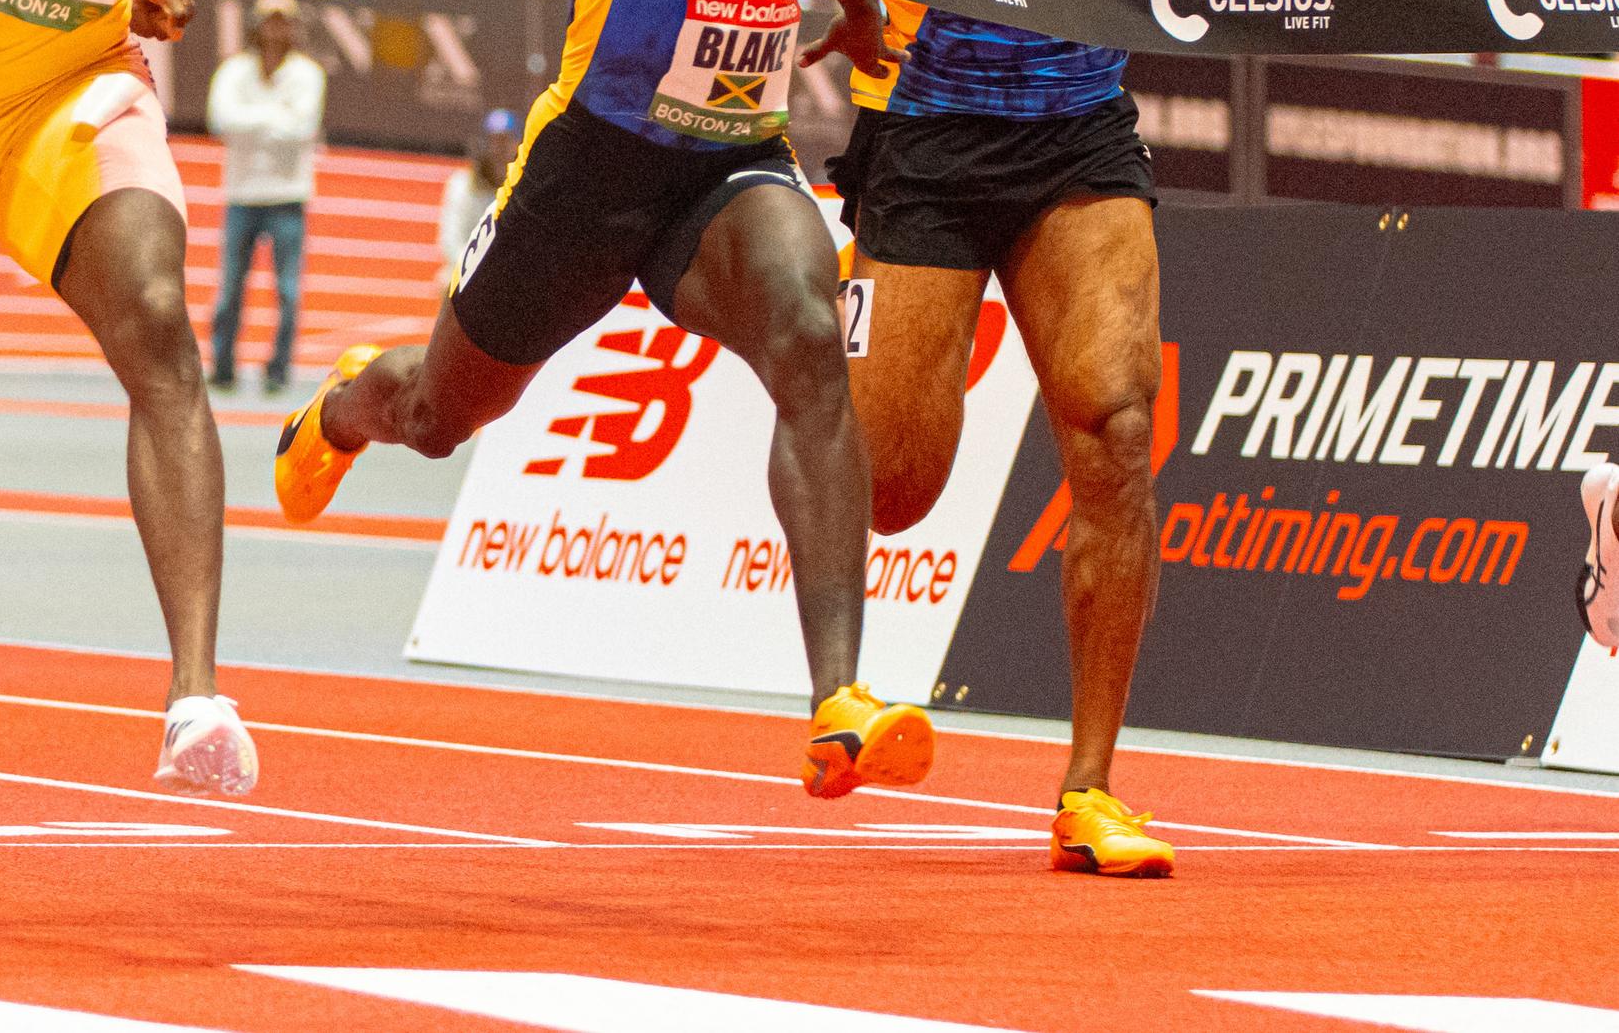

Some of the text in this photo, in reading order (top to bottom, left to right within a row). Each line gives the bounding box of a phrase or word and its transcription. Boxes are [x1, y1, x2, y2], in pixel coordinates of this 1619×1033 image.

[48, 2, 71, 22] 24
[1284, 16, 1331, 30] LIVE FIT
[692, 25, 791, 74] BLAKE
[655, 102, 752, 136] BOSTON 24
[846, 283, 866, 354] 2
[1191, 351, 1619, 472] PRIMETIME
[457, 506, 688, 586] new balance
[1160, 485, 1530, 601] ottiming.com
